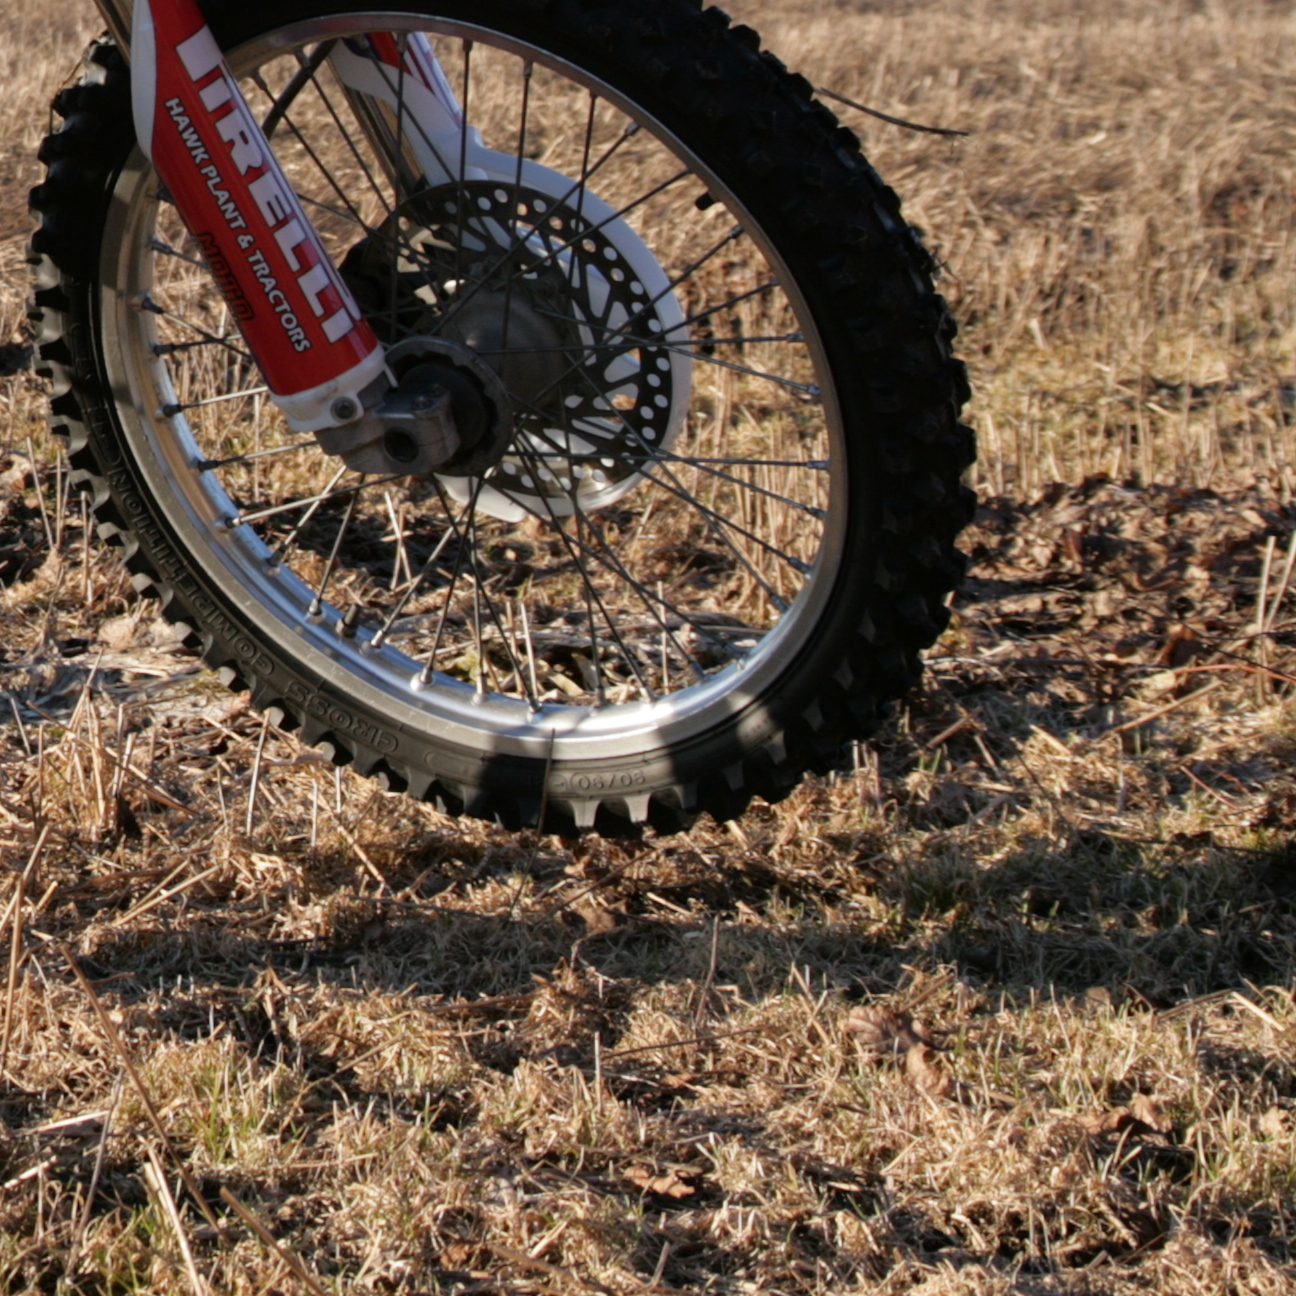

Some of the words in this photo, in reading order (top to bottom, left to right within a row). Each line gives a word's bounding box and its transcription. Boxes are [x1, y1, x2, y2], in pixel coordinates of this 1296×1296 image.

[165, 97, 210, 171] HAWK
[201, 164, 248, 231] PLANT
[237, 233, 255, 251] &
[247, 249, 311, 353] TRACTORS
[289, 681, 399, 754] CROSS
